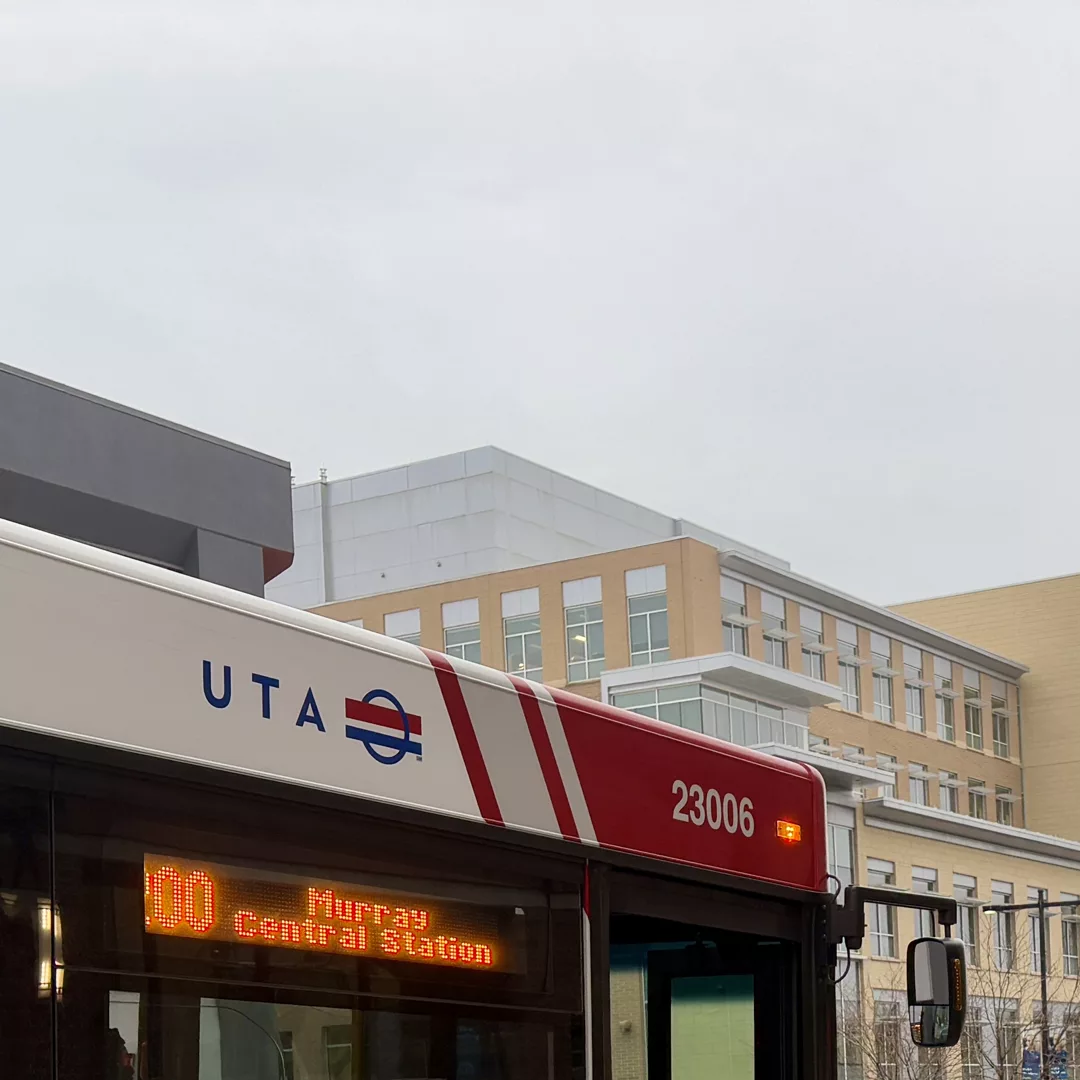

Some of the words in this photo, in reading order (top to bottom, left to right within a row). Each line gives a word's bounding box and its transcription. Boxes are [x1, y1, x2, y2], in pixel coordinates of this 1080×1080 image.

[203, 660, 326, 733] UTA
[672, 780, 755, 838] 23006
[145, 866, 216, 932] 00
[307, 887, 429, 931] Murray
[234, 909, 367, 951] Central
[380, 927, 493, 966] Station
